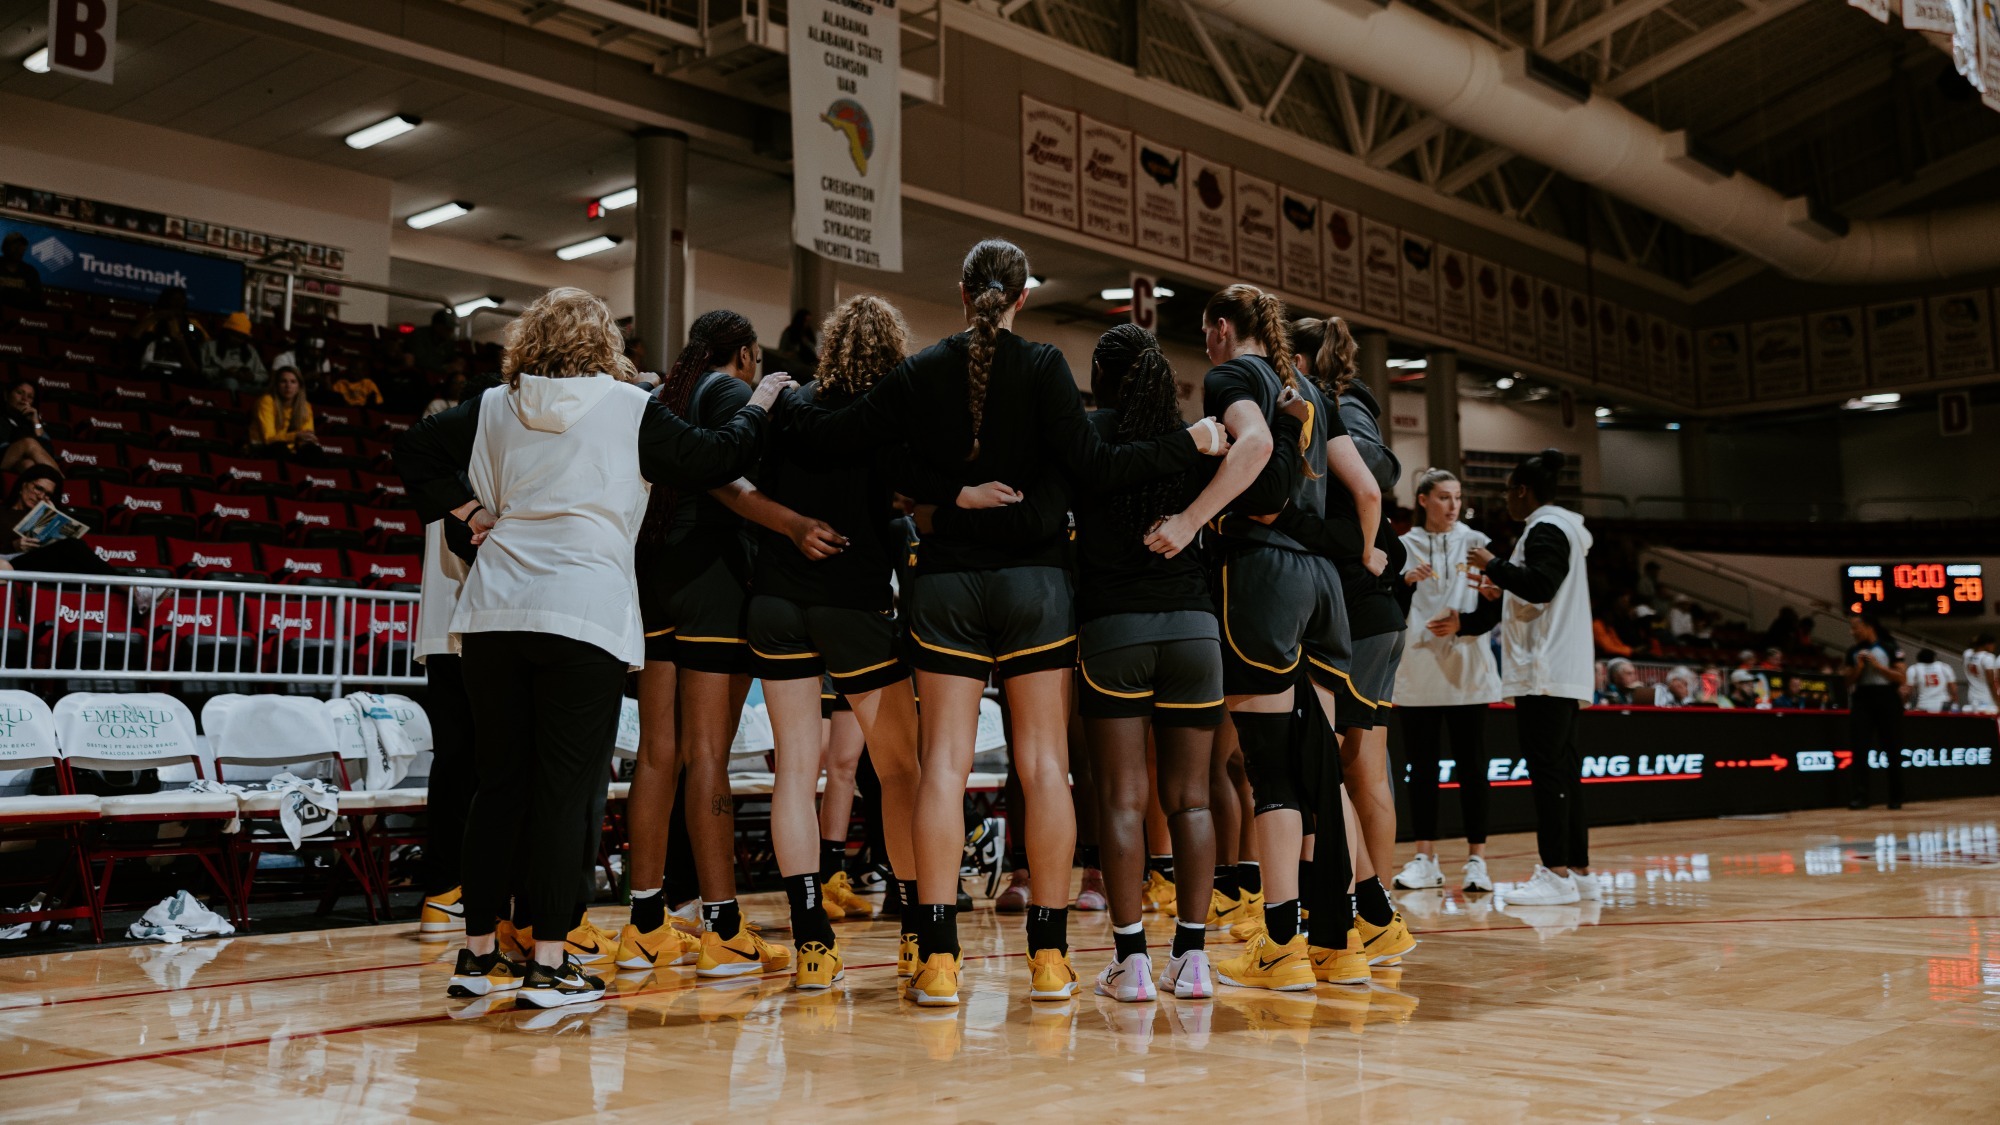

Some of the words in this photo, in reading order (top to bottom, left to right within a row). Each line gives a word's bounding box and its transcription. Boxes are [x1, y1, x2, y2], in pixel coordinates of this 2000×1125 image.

[54, 0, 107, 73] B
[822, 10, 869, 37] ALABAMA
[808, 25, 854, 52] ALABAMA
[857, 41, 883, 64] STATE
[824, 51, 868, 78] CLEMSON
[837, 75, 857, 95] UAB
[822, 176, 875, 203] CREIGHTON
[825, 198, 872, 223] MISSOURI
[823, 219, 871, 245] SYRACUSE
[813, 238, 853, 260] WICHITA
[855, 248, 880, 269] STATE
[78, 251, 188, 289] Trustmark
[1134, 278, 1153, 329] C
[1854, 579, 1884, 601] 44
[1954, 577, 1982, 601] 28
[1937, 595, 1950, 614] 3
[81, 709, 174, 725] EMERALD
[97, 723, 159, 739] COAST
[1637, 754, 1704, 776] LIVE
